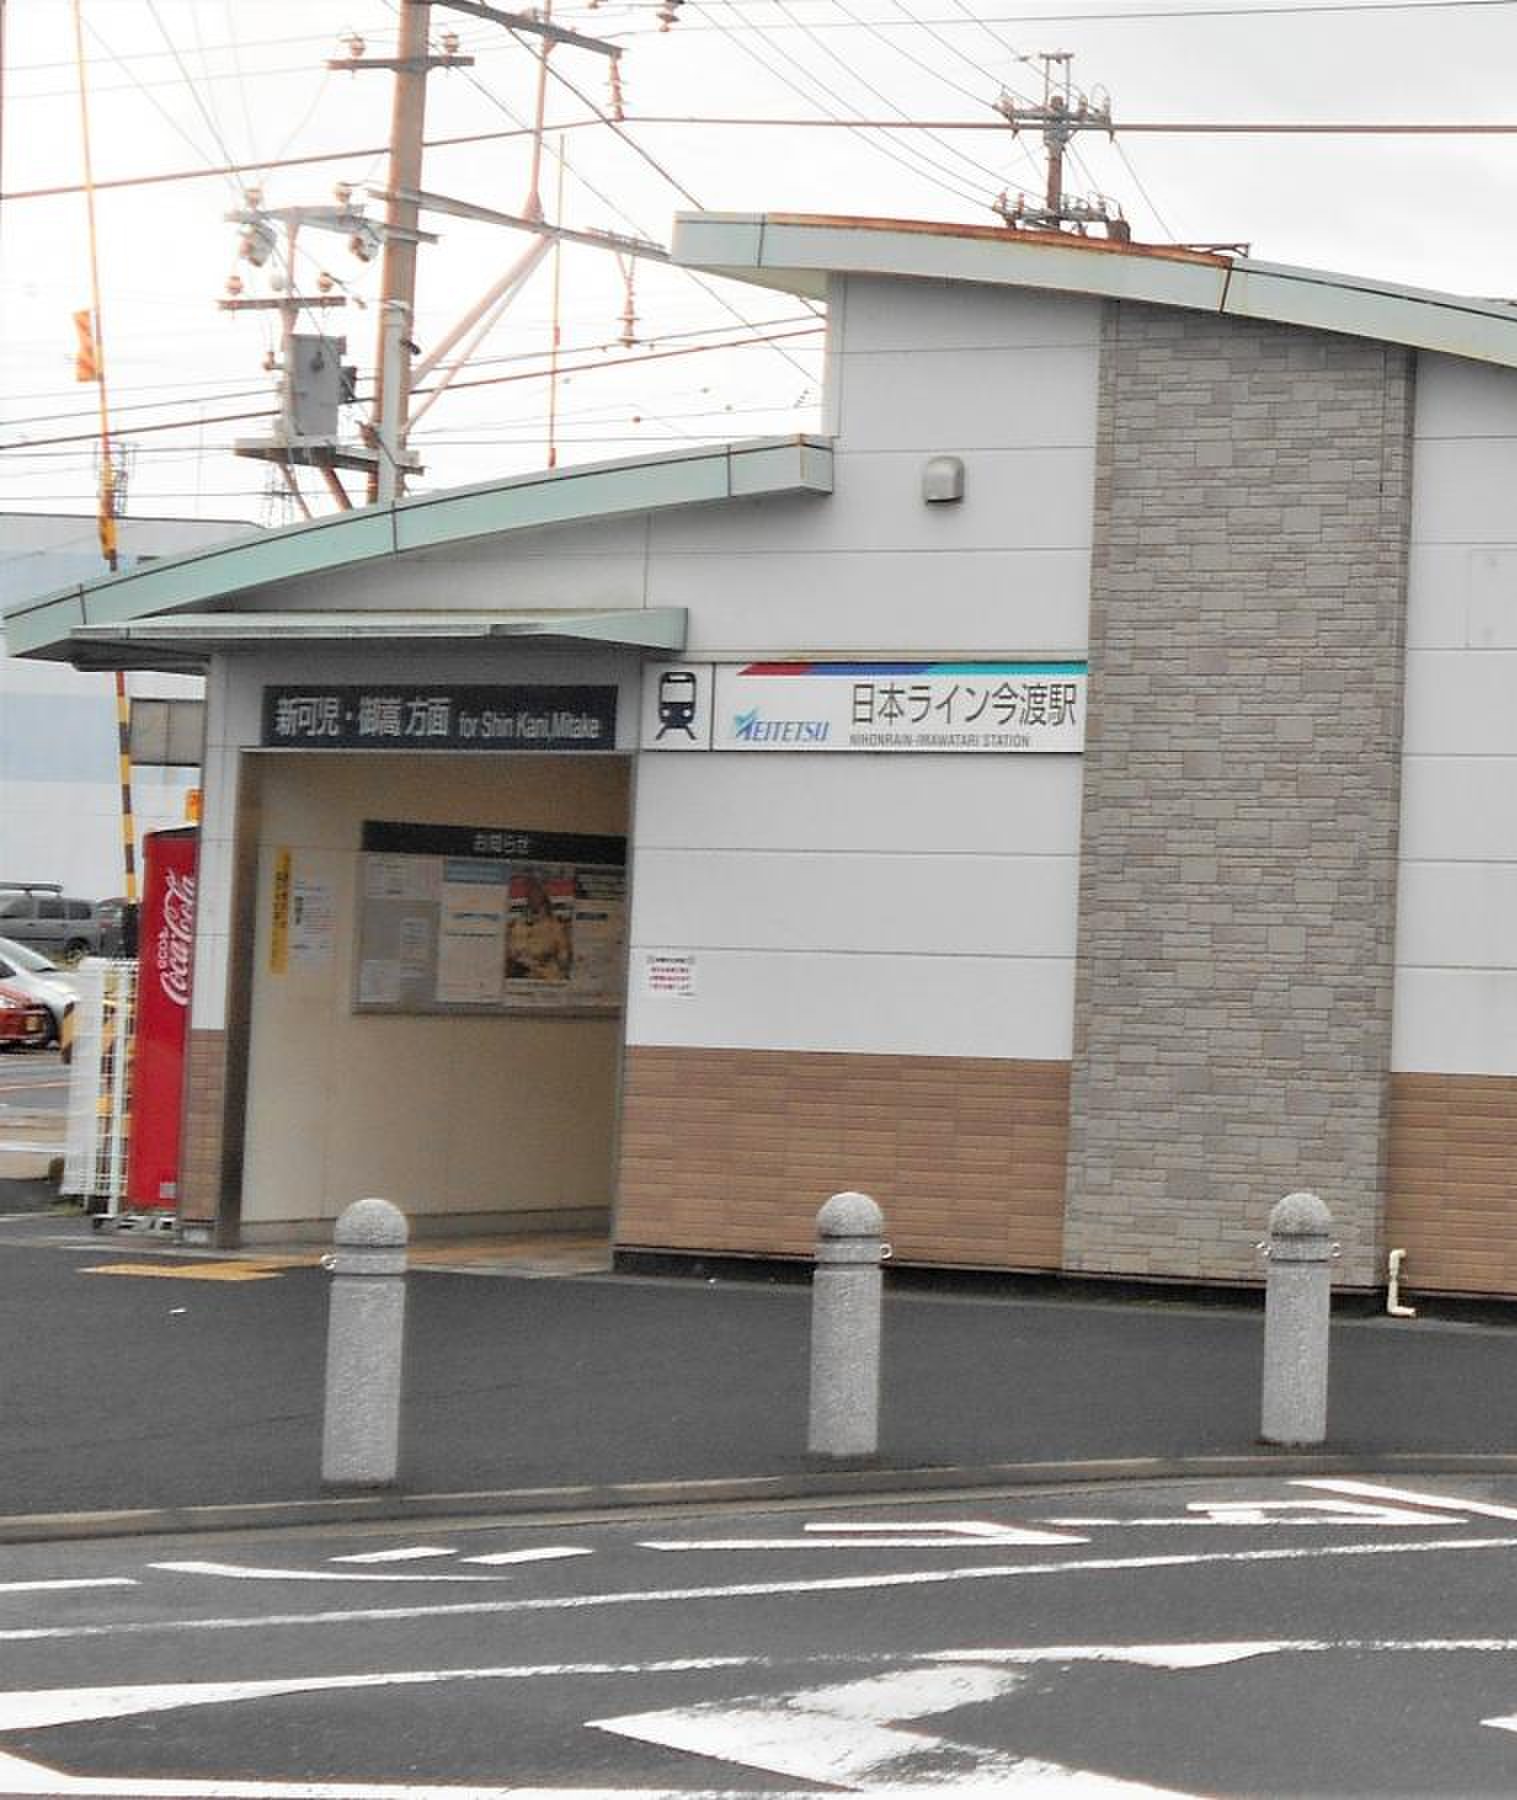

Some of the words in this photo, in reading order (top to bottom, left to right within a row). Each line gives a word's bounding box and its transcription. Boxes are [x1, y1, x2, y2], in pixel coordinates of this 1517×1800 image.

[853, 683, 1077, 727] 日本ライン今渡駅
[459, 712, 479, 738] for
[481, 711, 513, 738] Shin
[734, 706, 831, 742] MEITETSU
[849, 733, 979, 748] NIHONRAIN-IMAWATARI
[982, 734, 1030, 748] STATION
[472, 833, 533, 855] お知らせ
[160, 868, 195, 1006] Coca-Cola
